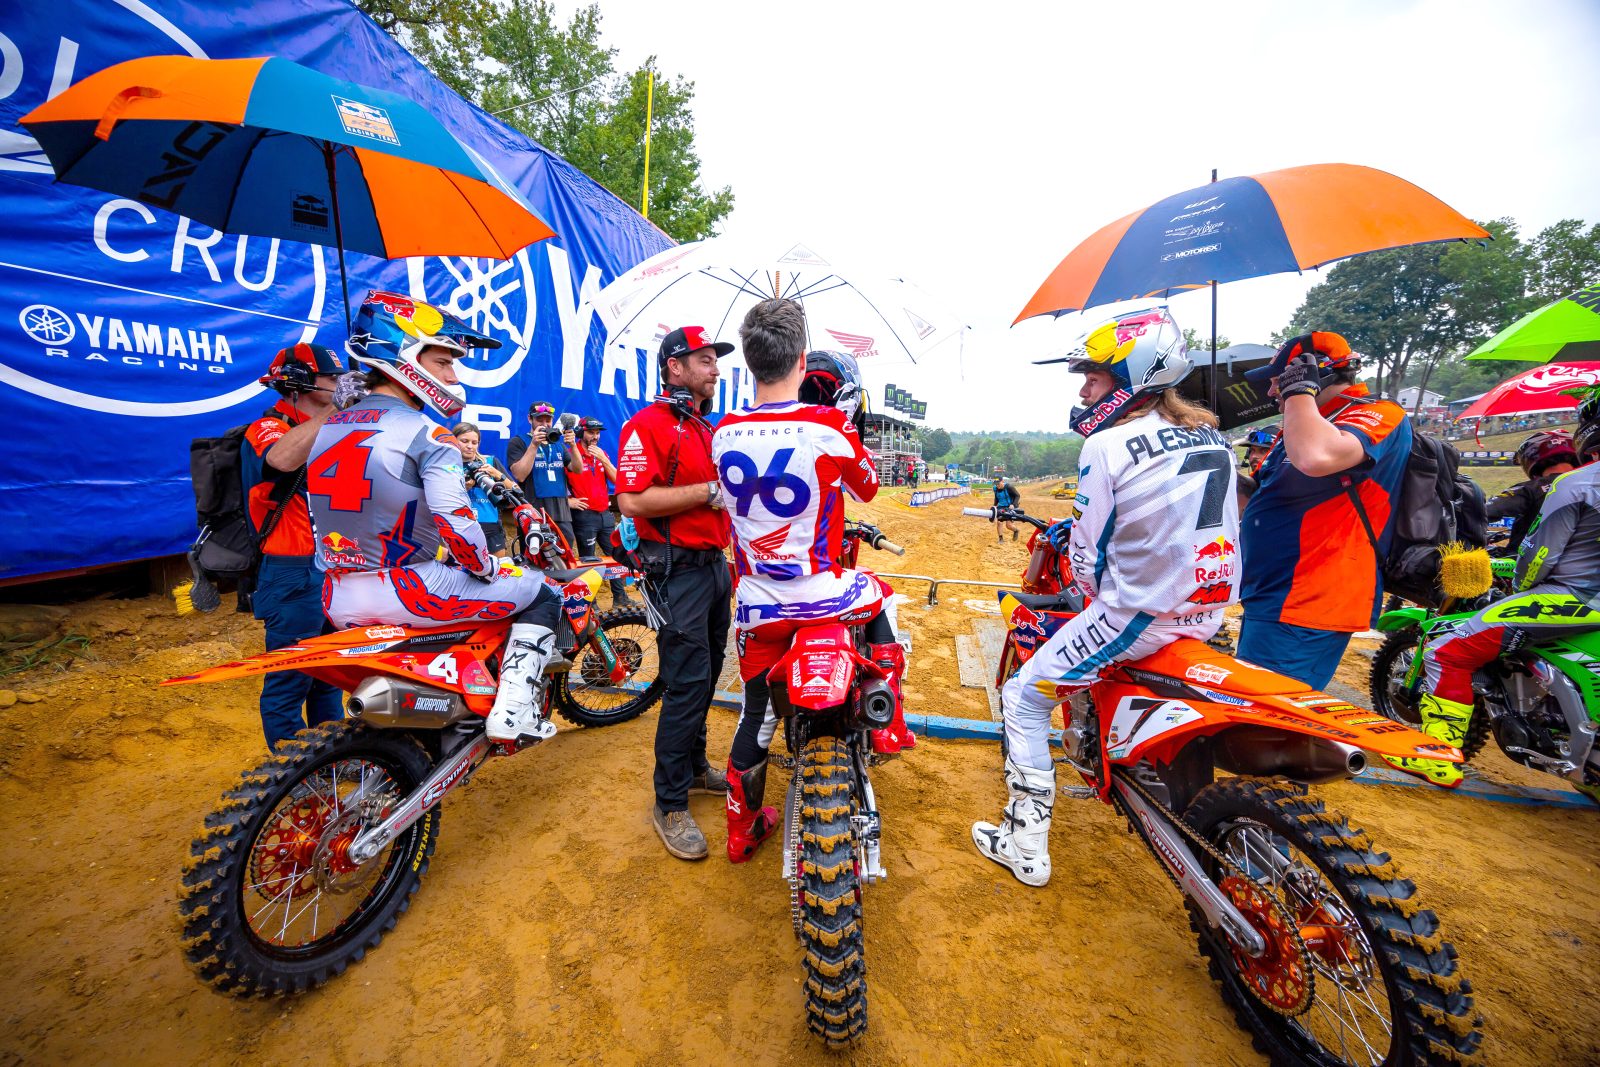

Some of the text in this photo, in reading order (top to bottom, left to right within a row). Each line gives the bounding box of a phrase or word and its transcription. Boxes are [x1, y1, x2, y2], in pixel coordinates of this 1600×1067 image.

[1175, 244, 1218, 259] MOTOREX
[76, 312, 233, 364] YAMAHA
[46, 347, 225, 374] RACING
[1101, 388, 1133, 417] Bull
[719, 427, 804, 440] LAWRENCE
[307, 430, 384, 513] 4
[719, 447, 811, 518] 96
[1176, 449, 1232, 531] 7
[753, 553, 797, 561] HONDA
[348, 643, 388, 655] PROGRESSIVE
[428, 653, 458, 684] 4
[1206, 690, 1246, 706] PROGRESSIVE
[1128, 698, 1171, 744] 7
[1279, 715, 1359, 739] DUNLOP
